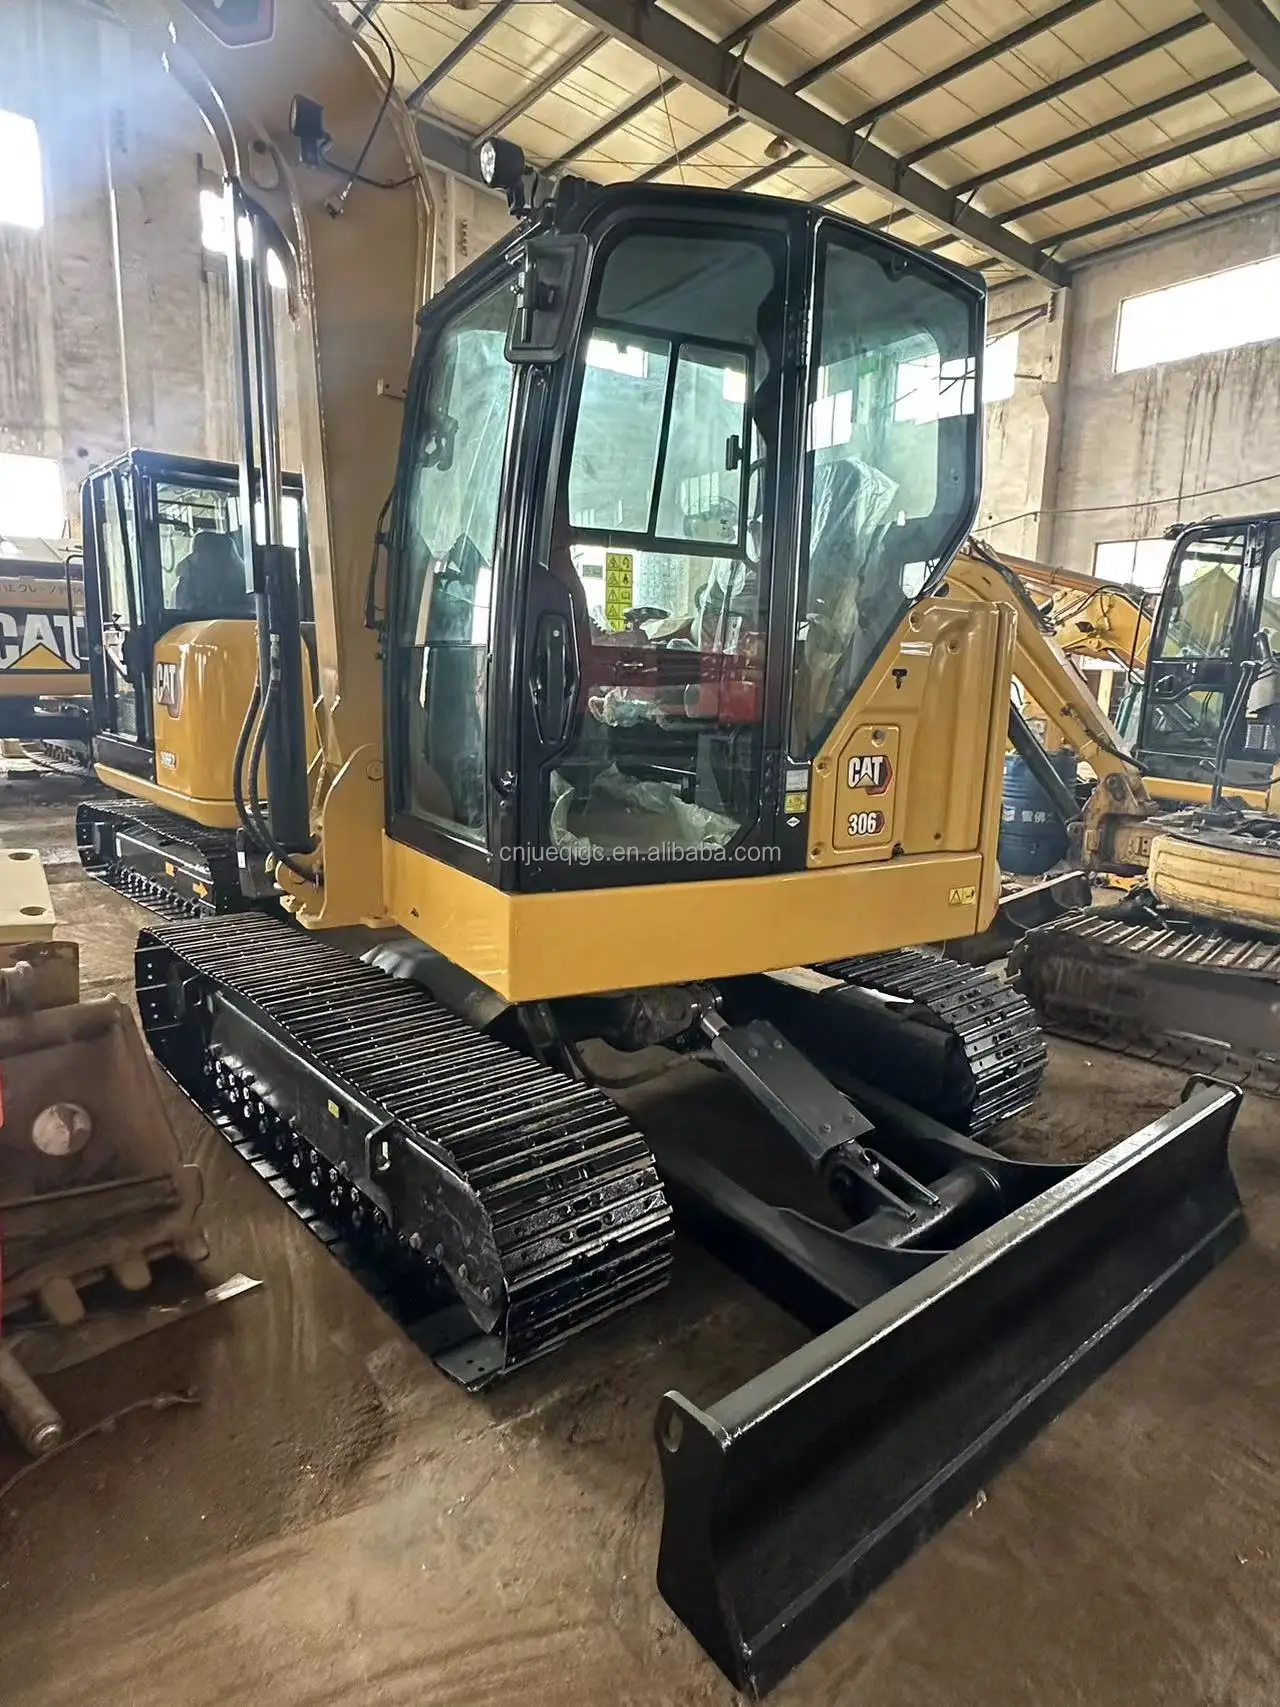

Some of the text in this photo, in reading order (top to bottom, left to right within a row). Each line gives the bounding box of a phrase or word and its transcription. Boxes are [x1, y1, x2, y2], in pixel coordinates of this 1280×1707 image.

[0, 612, 84, 670] CAT
[156, 663, 177, 705] CAT
[847, 756, 884, 789] CAT
[848, 812, 878, 836] 306
